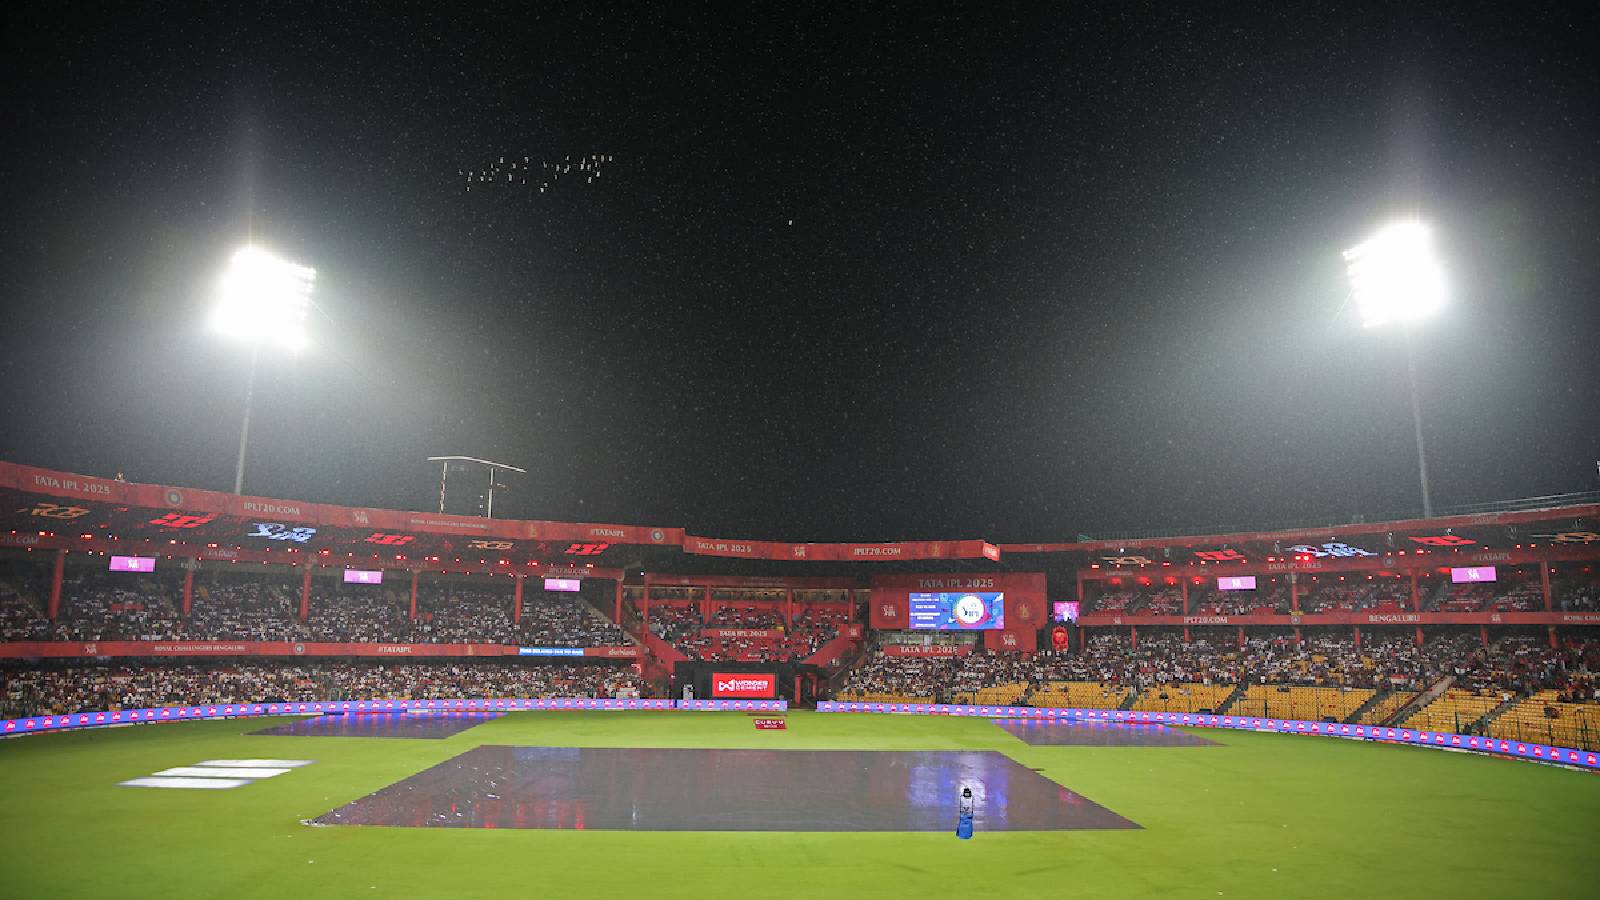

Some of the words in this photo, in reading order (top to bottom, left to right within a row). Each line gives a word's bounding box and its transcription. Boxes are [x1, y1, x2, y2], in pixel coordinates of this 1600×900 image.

[33, 475, 60, 488] TATA
[63, 481, 79, 490] IPL
[83, 484, 112, 495] 2025
[697, 542, 714, 550] TATA
[716, 543, 729, 551] IPL
[731, 544, 752, 553] 2025
[854, 547, 901, 556] IPLT20.COM
[919, 579, 944, 588] TATA
[947, 579, 963, 588] IPL
[966, 578, 994, 588] 2025
